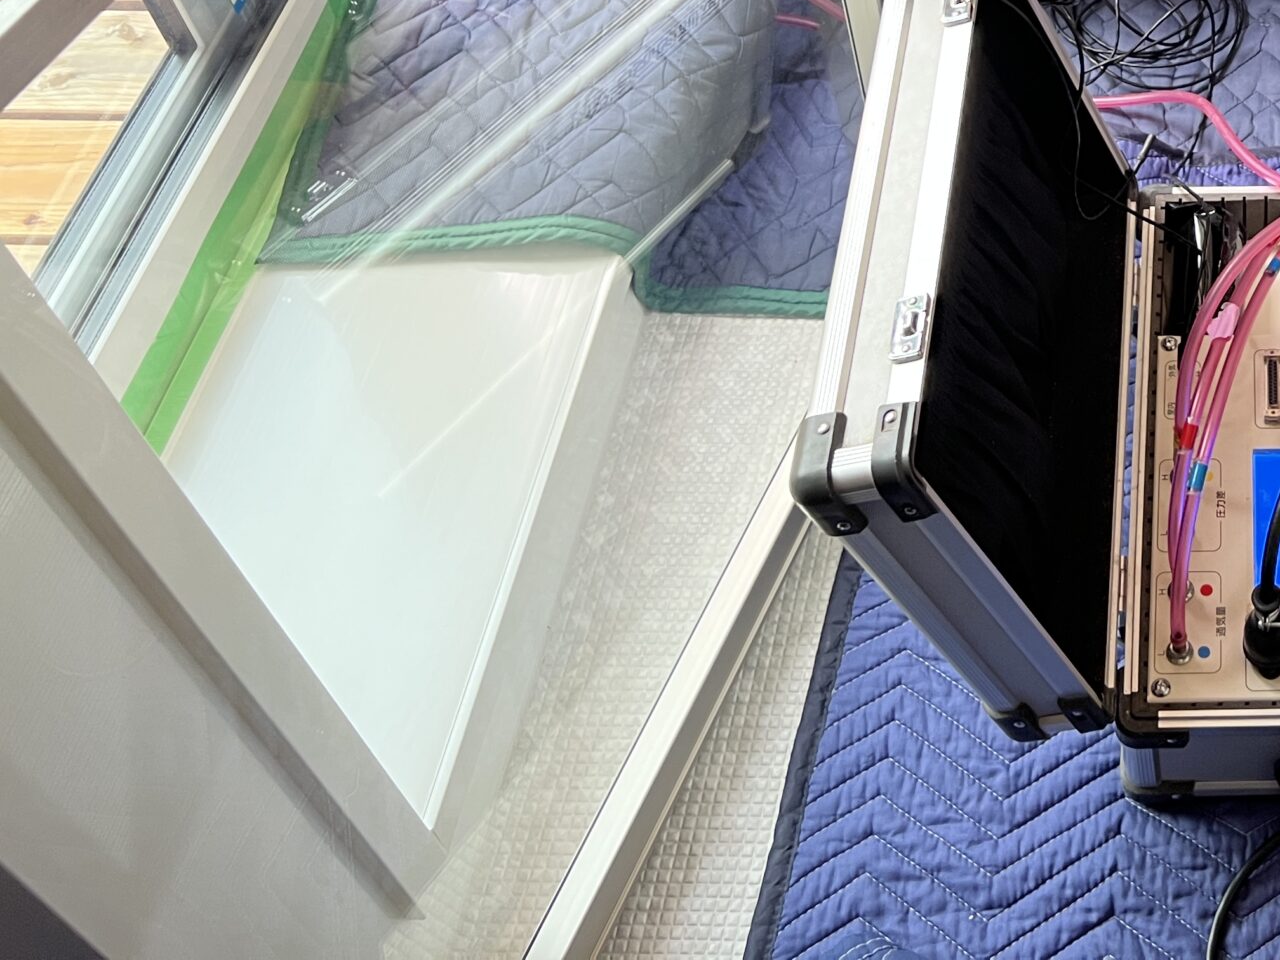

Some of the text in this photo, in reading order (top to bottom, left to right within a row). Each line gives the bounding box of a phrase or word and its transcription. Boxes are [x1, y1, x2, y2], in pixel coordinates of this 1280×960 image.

[1216, 490, 1226, 519] 圧力差
[1215, 606, 1226, 637] 通気量
